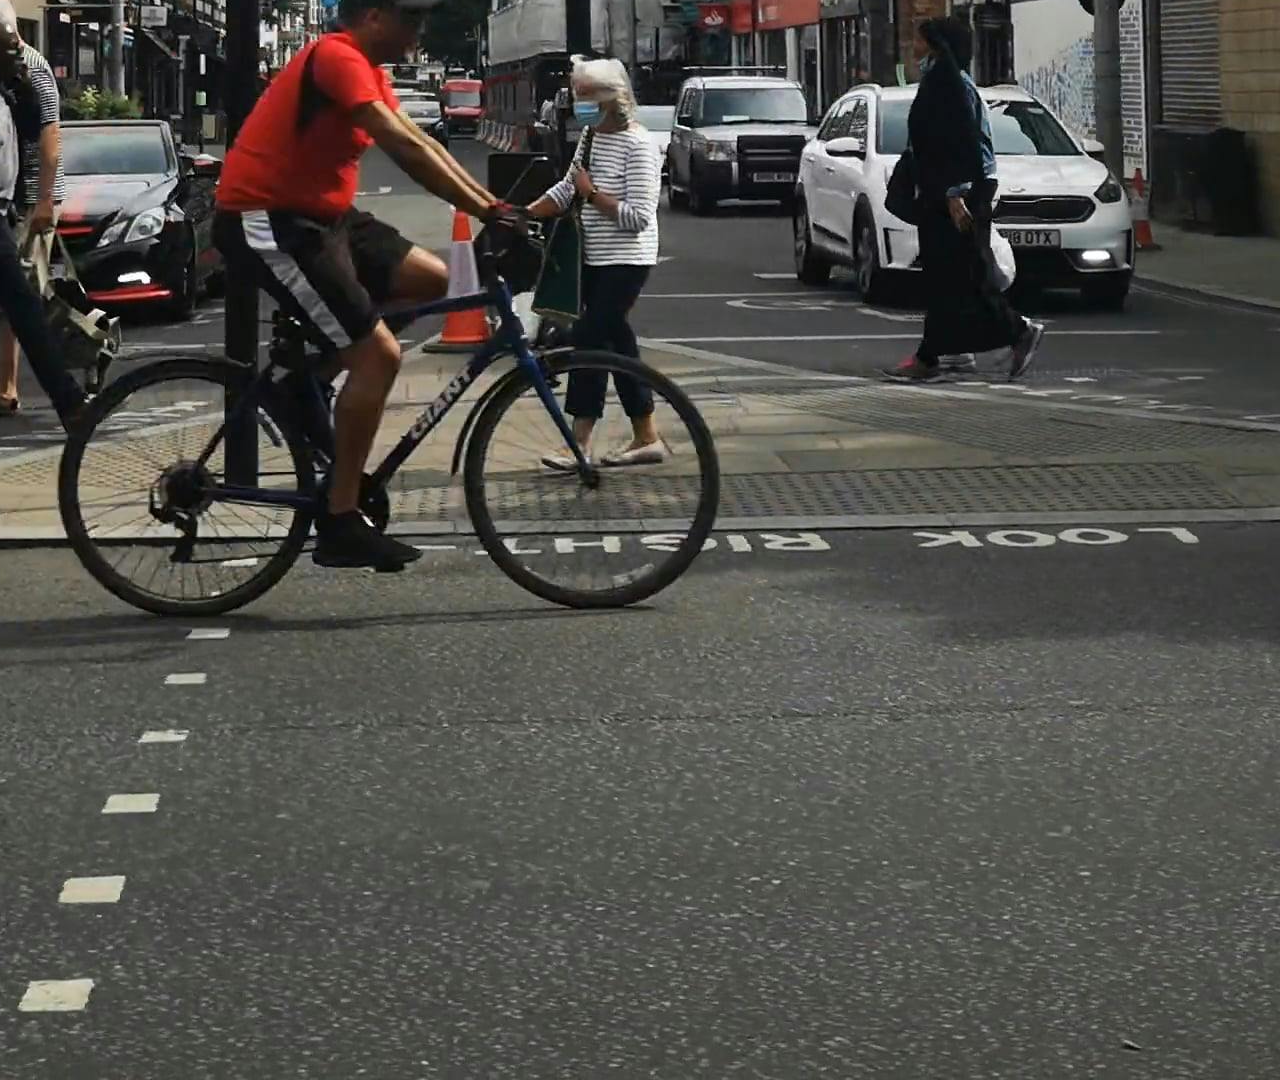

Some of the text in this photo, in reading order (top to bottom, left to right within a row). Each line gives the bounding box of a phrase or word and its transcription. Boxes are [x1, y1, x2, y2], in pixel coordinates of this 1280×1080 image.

[410, 366, 472, 441] GIANT
[473, 526, 1200, 556] LOOK RIGHT
